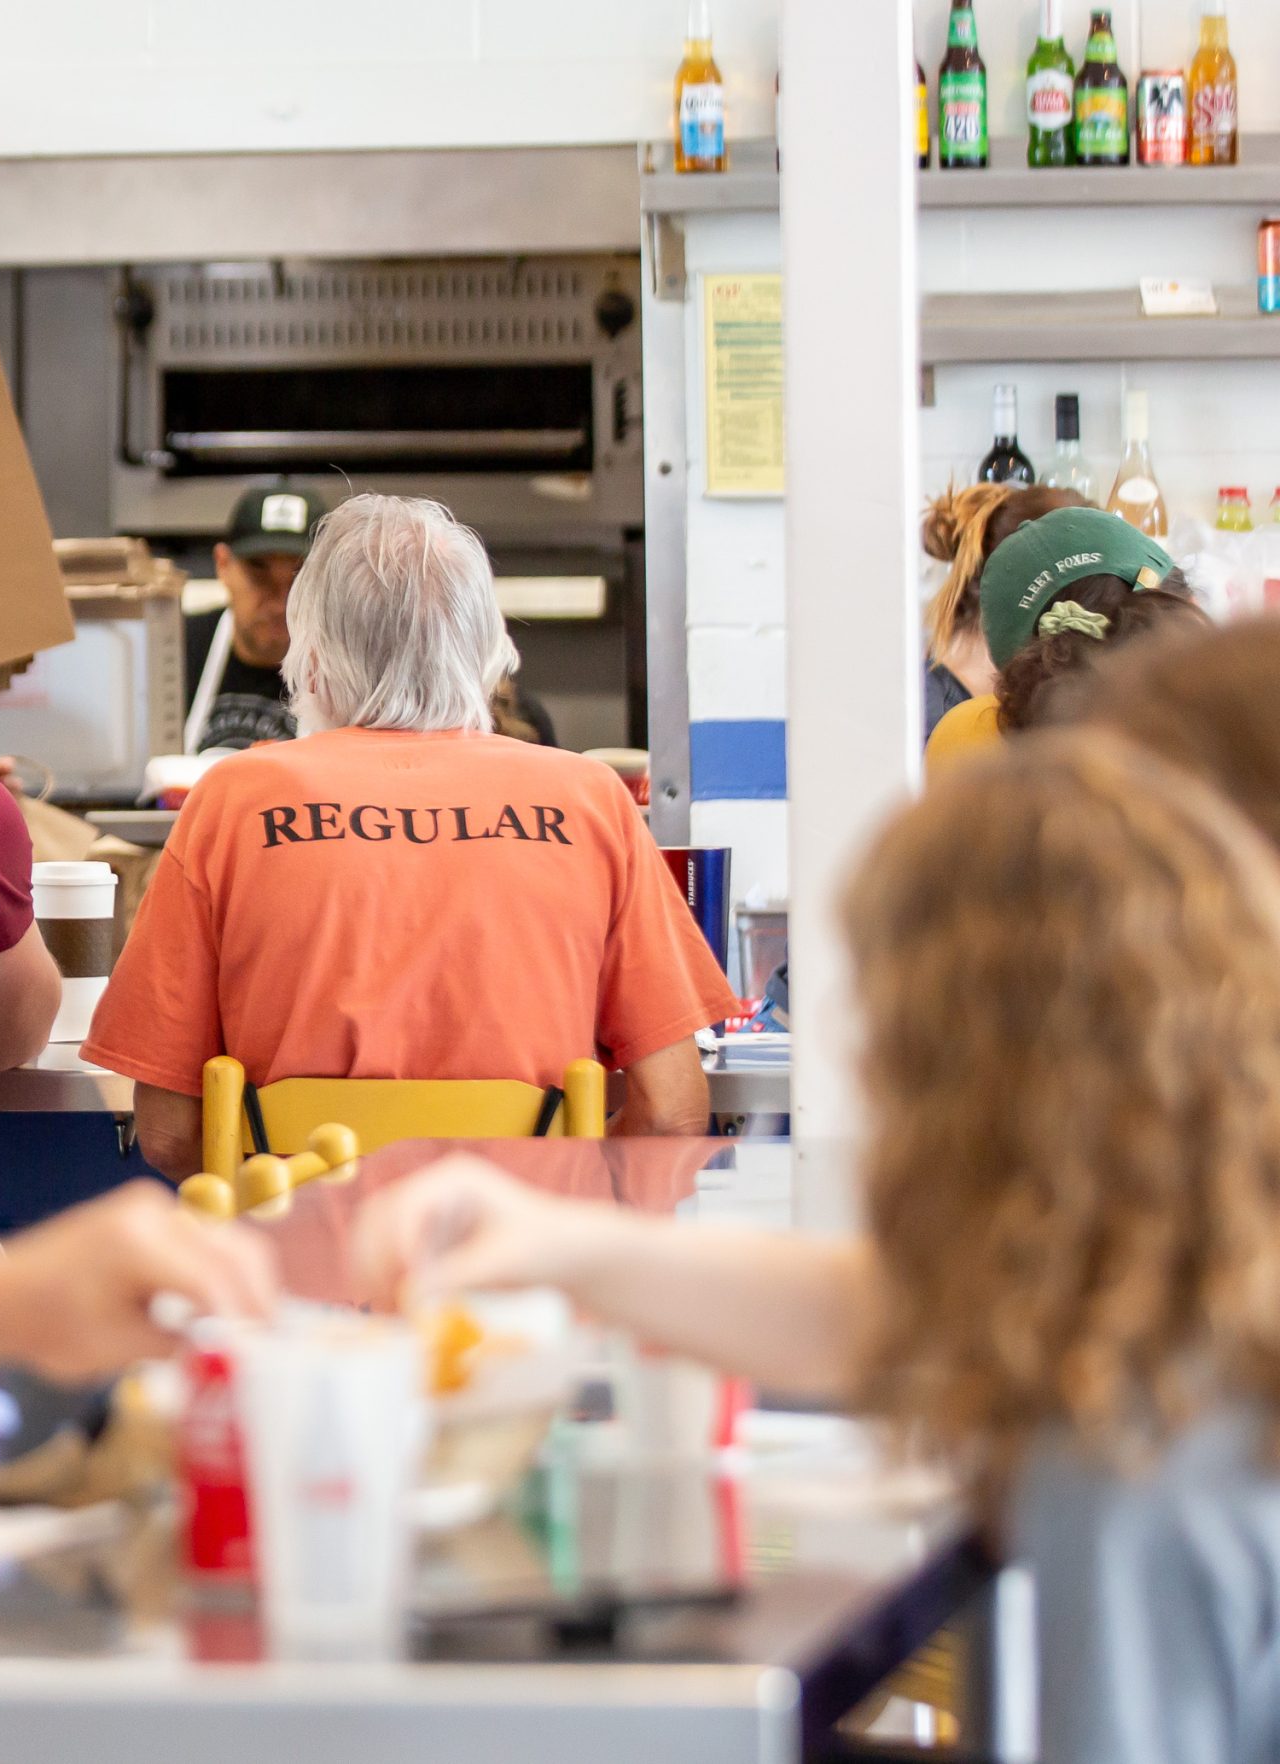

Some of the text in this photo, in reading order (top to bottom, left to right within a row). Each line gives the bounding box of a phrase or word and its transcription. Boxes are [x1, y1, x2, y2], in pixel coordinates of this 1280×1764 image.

[1018, 552, 1103, 609] FLEET FOXES
[258, 802, 573, 848] REGULAR
